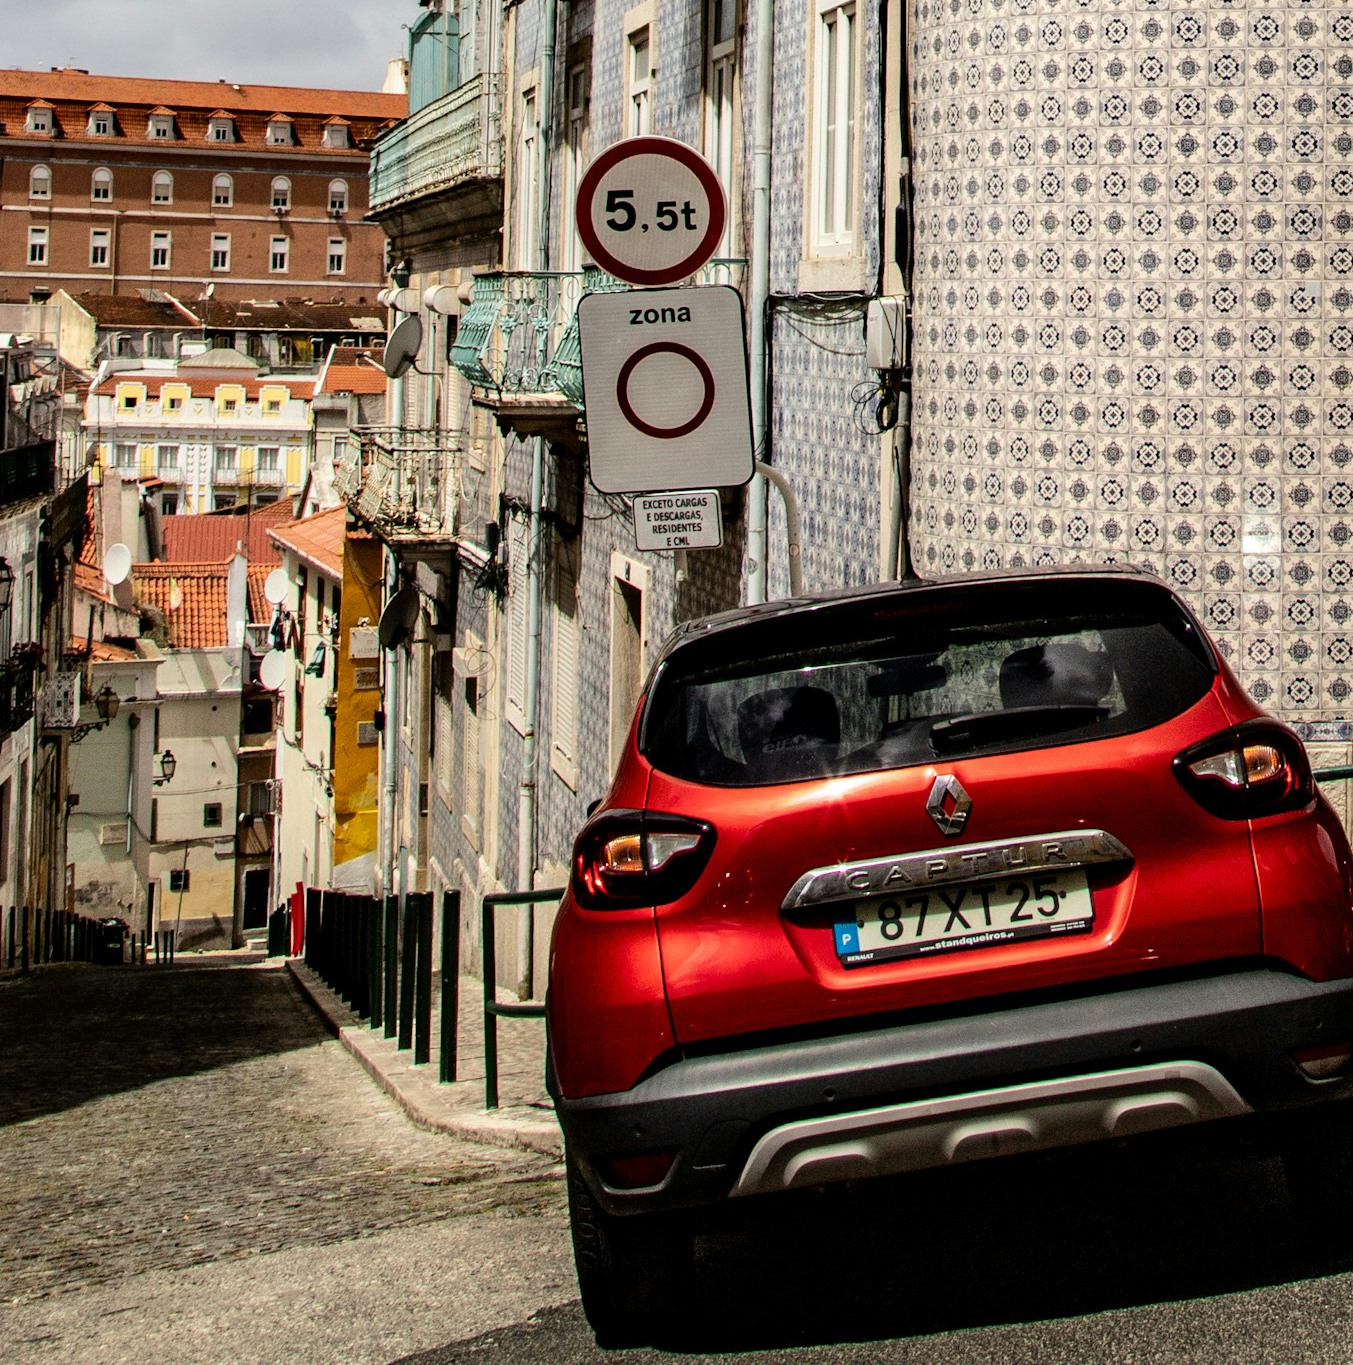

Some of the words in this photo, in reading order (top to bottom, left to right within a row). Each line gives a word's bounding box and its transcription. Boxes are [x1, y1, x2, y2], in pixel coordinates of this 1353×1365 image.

[605, 189, 698, 233] 5,5t
[629, 305, 692, 325] zona
[642, 498, 674, 510] EXCETO
[675, 497, 708, 508] CARGAS
[646, 512, 652, 522] E
[653, 510, 704, 521] DESCARGAS,
[652, 522, 702, 534] RESIDENTES
[666, 537, 672, 546] E
[673, 536, 690, 546] CML
[846, 841, 1068, 890] CAPTUR
[841, 932, 852, 946] P
[847, 952, 874, 962] RENAULT
